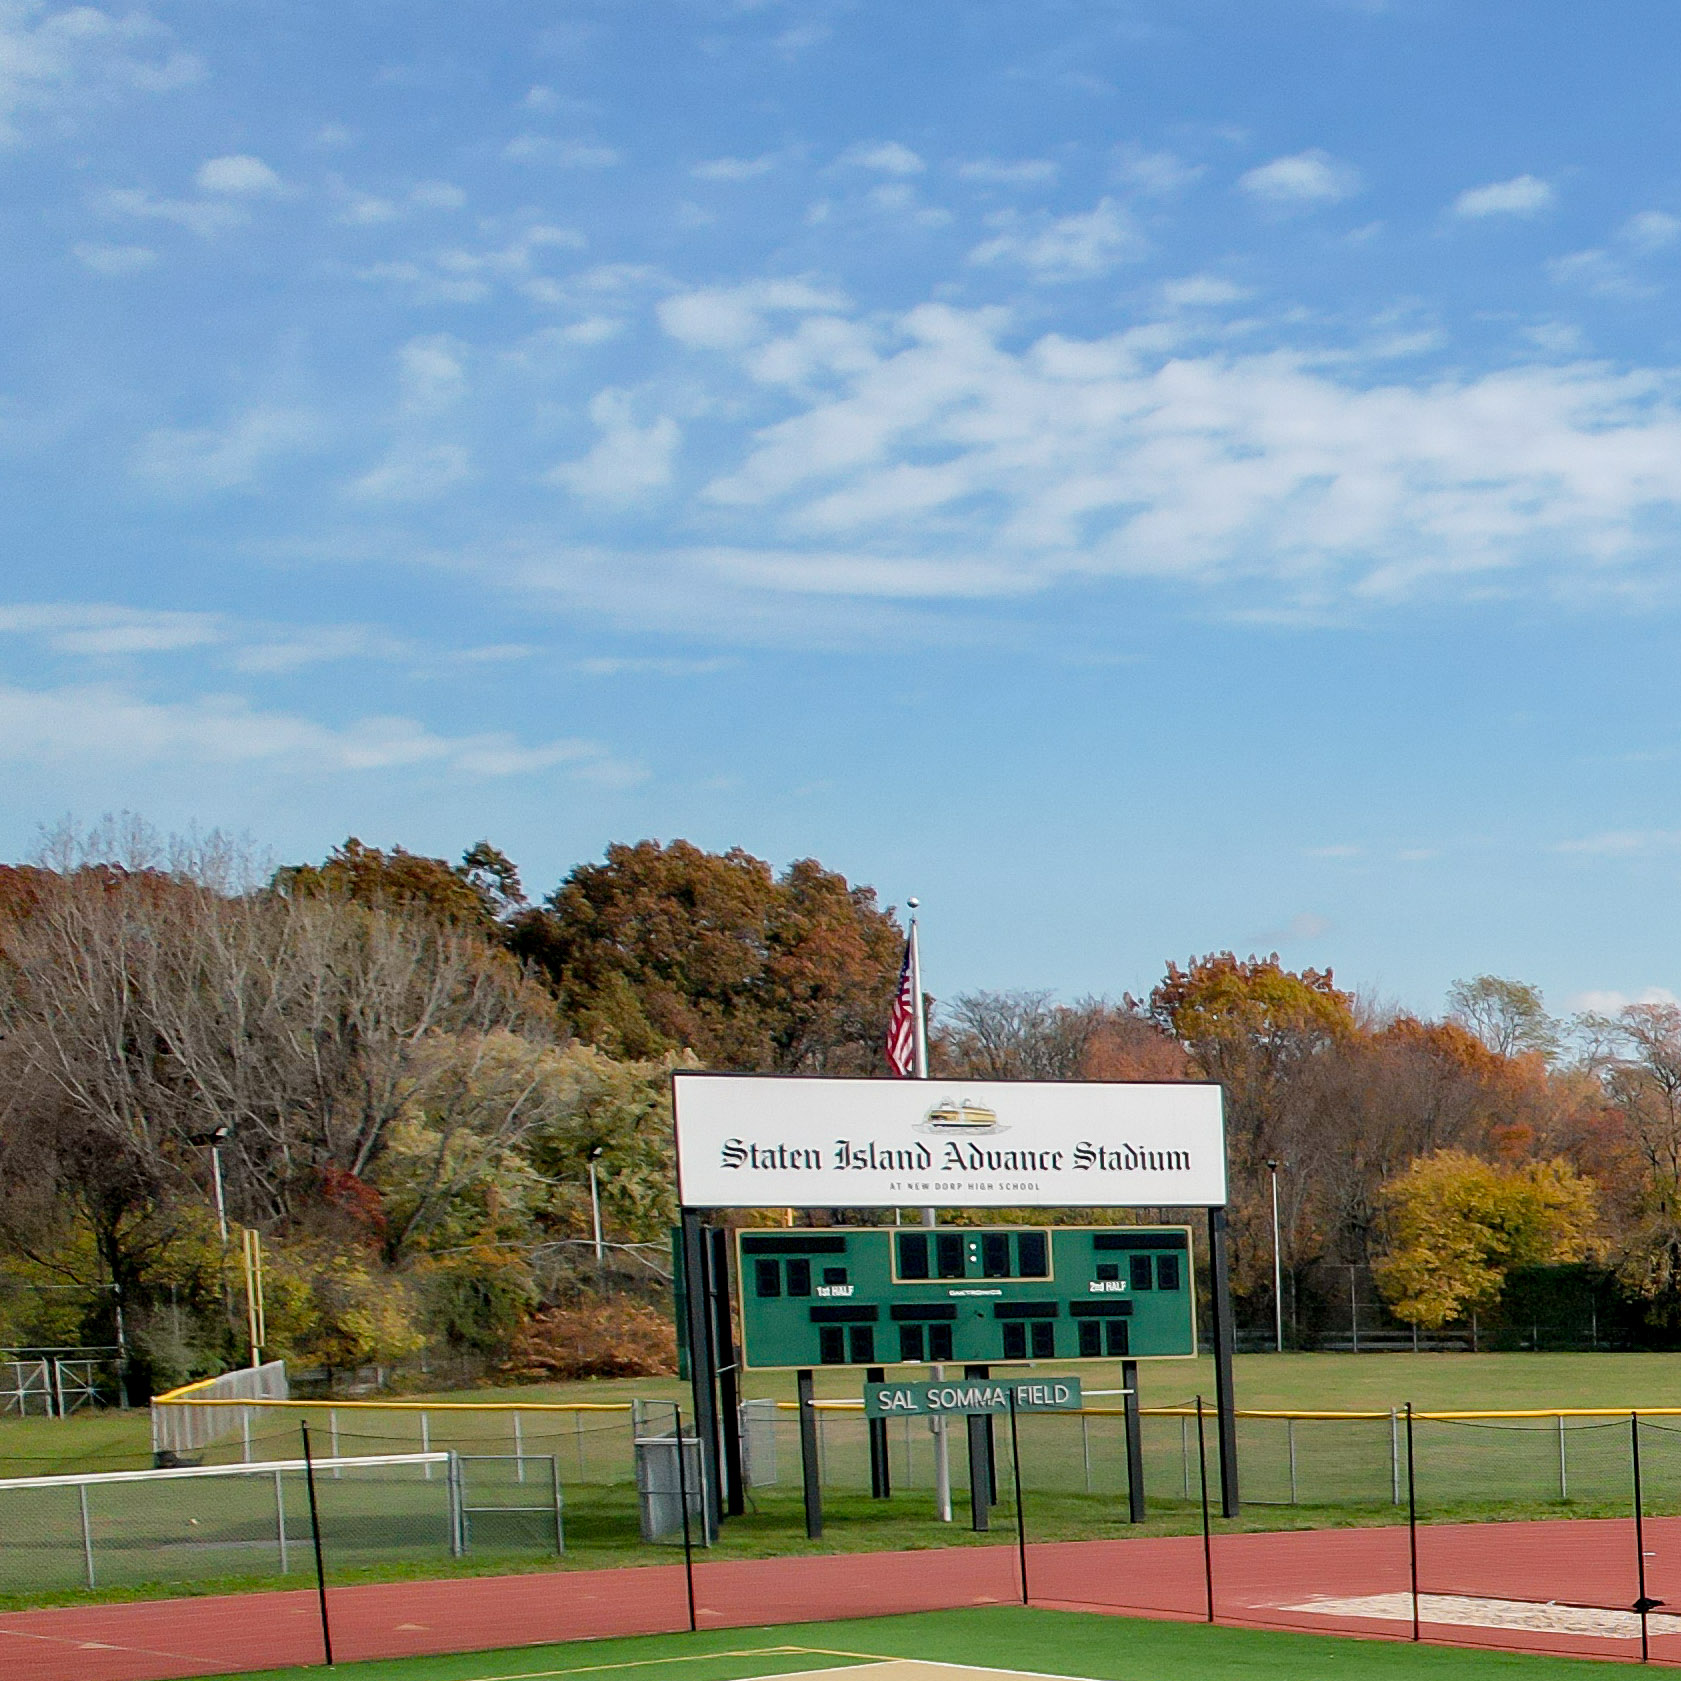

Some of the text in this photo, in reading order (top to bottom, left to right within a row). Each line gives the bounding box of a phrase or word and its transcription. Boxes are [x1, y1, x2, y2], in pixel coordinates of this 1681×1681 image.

[720, 1138, 1191, 1171] Staten Island Advance Stadium
[889, 1182, 1040, 1191] AT NEW DORP HIGH SCHOOL
[816, 1285, 854, 1297] 1st HALF
[1105, 1280, 1127, 1292] HALF
[878, 1384, 1070, 1410] SAL SOMMA FIELD
